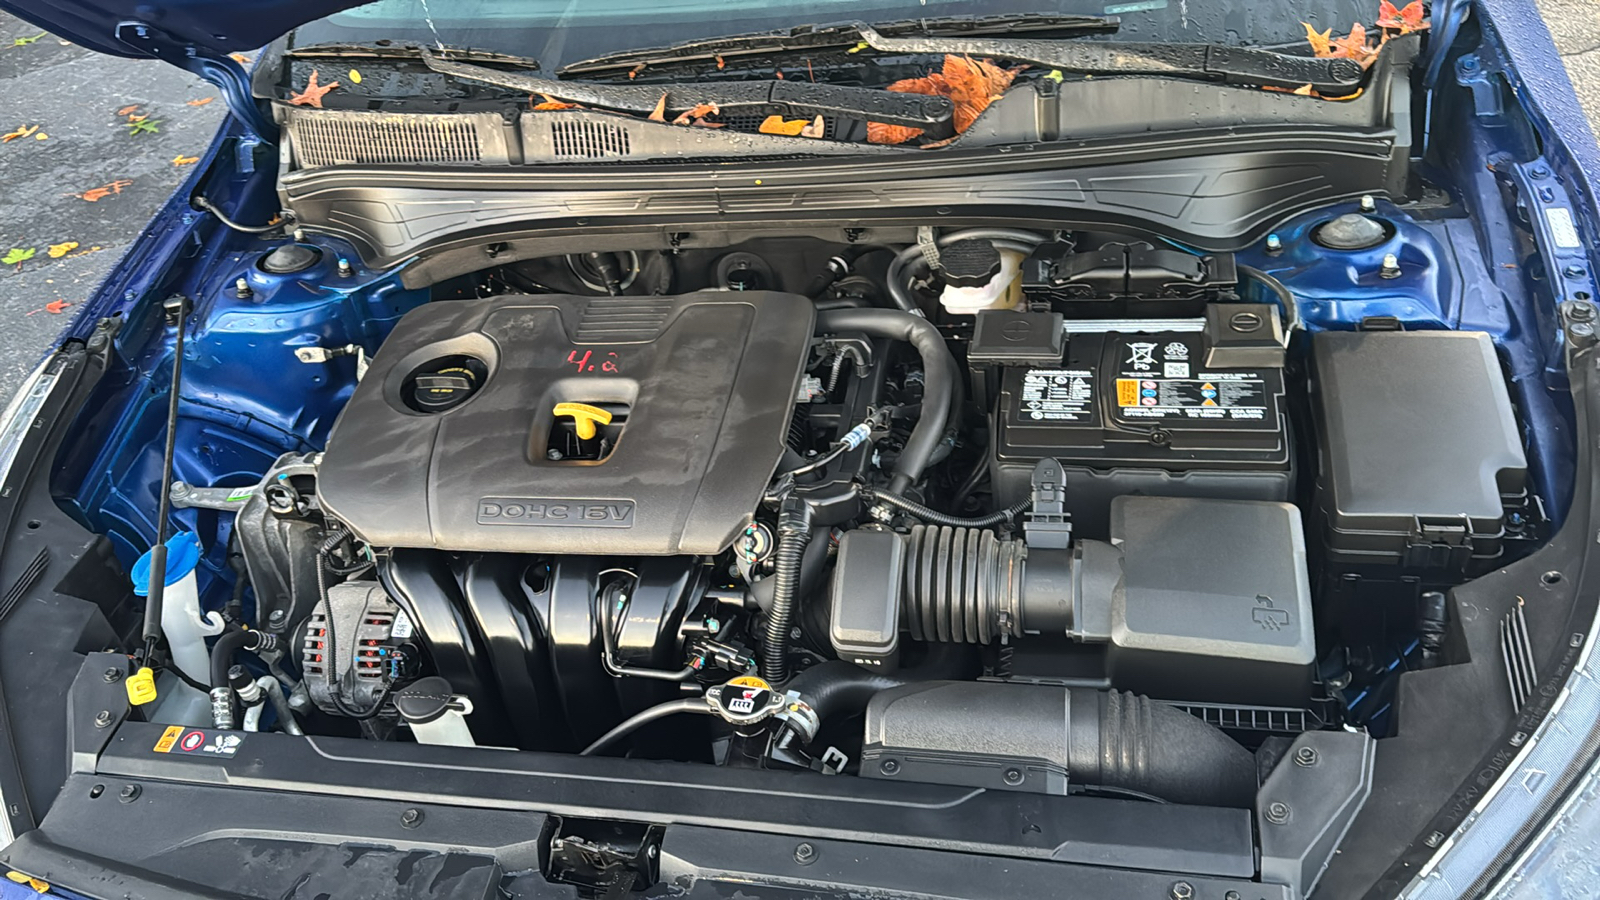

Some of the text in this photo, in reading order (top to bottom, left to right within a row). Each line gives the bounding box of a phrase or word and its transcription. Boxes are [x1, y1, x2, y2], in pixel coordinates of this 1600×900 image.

[1133, 363, 1151, 371] Pb
[480, 502, 633, 521] DOHC 16V
